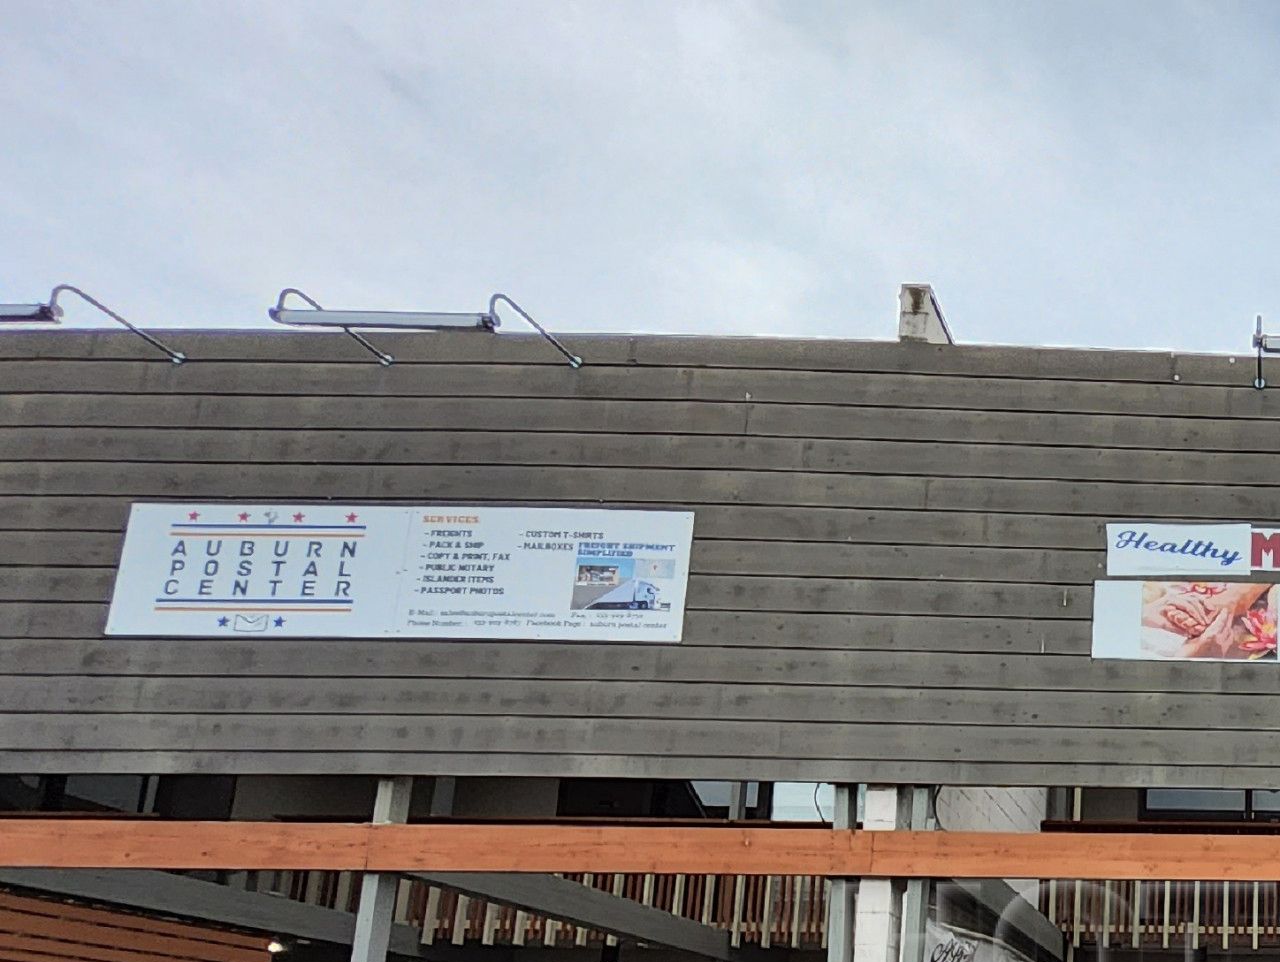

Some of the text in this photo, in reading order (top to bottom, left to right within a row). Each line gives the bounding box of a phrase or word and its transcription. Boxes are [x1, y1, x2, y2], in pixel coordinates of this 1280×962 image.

[423, 515, 480, 524] SERVICES
[525, 530, 604, 540] CUSTOM T-SHIRTS
[171, 540, 357, 558] AUBURN
[428, 540, 453, 549] PACK
[464, 541, 485, 549] SHIP
[523, 542, 574, 551] MAILBOXES
[1115, 530, 1243, 566] Healthy
[427, 552, 450, 560] COPY
[492, 553, 511, 561] FAX
[169, 560, 353, 577] POSTAL
[425, 563, 495, 572] PUBLIC NOTARY
[467, 575, 495, 583] ITEMS
[163, 579, 352, 597] CENTER
[420, 587, 505, 595] PASSPORT PHOTOS
